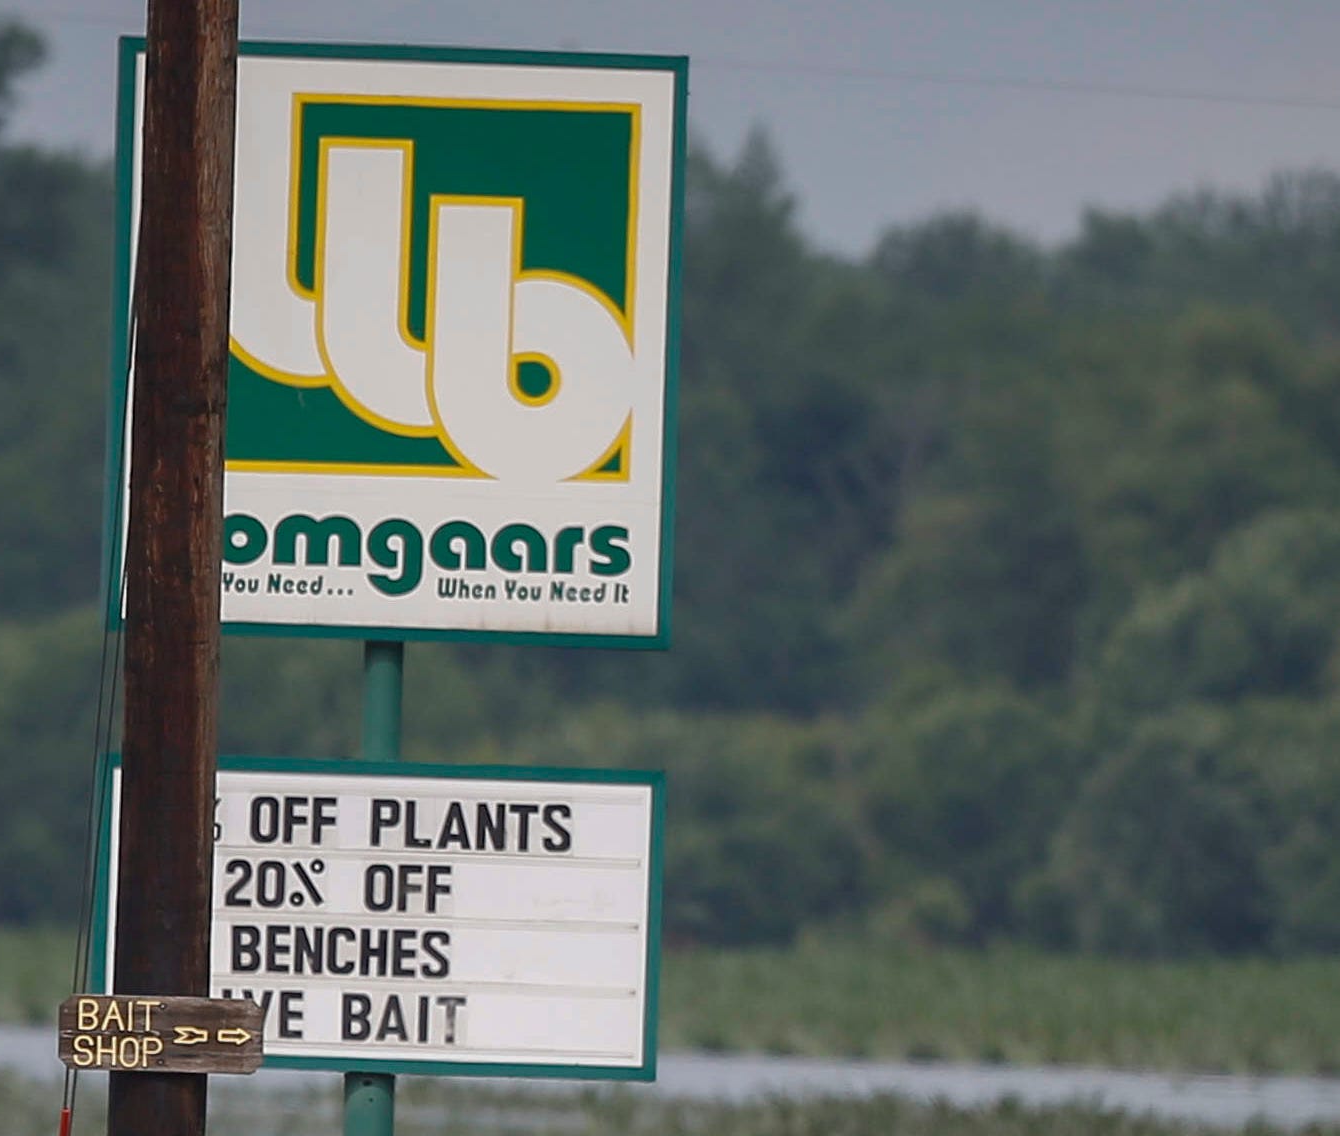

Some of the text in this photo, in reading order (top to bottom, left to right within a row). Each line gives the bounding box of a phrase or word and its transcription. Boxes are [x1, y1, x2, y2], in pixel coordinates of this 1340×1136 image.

[223, 514, 629, 596] omgaars
[222, 572, 259, 594] You
[437, 577, 629, 603] When You Need It
[249, 796, 337, 845] OFF
[369, 798, 572, 852] PLANTS
[224, 859, 452, 913] 20% OFF
[231, 925, 450, 978] BENCHES
[77, 999, 162, 1033] BAIT
[342, 992, 467, 1044] BAIT
[72, 1034, 163, 1069] SHOP
